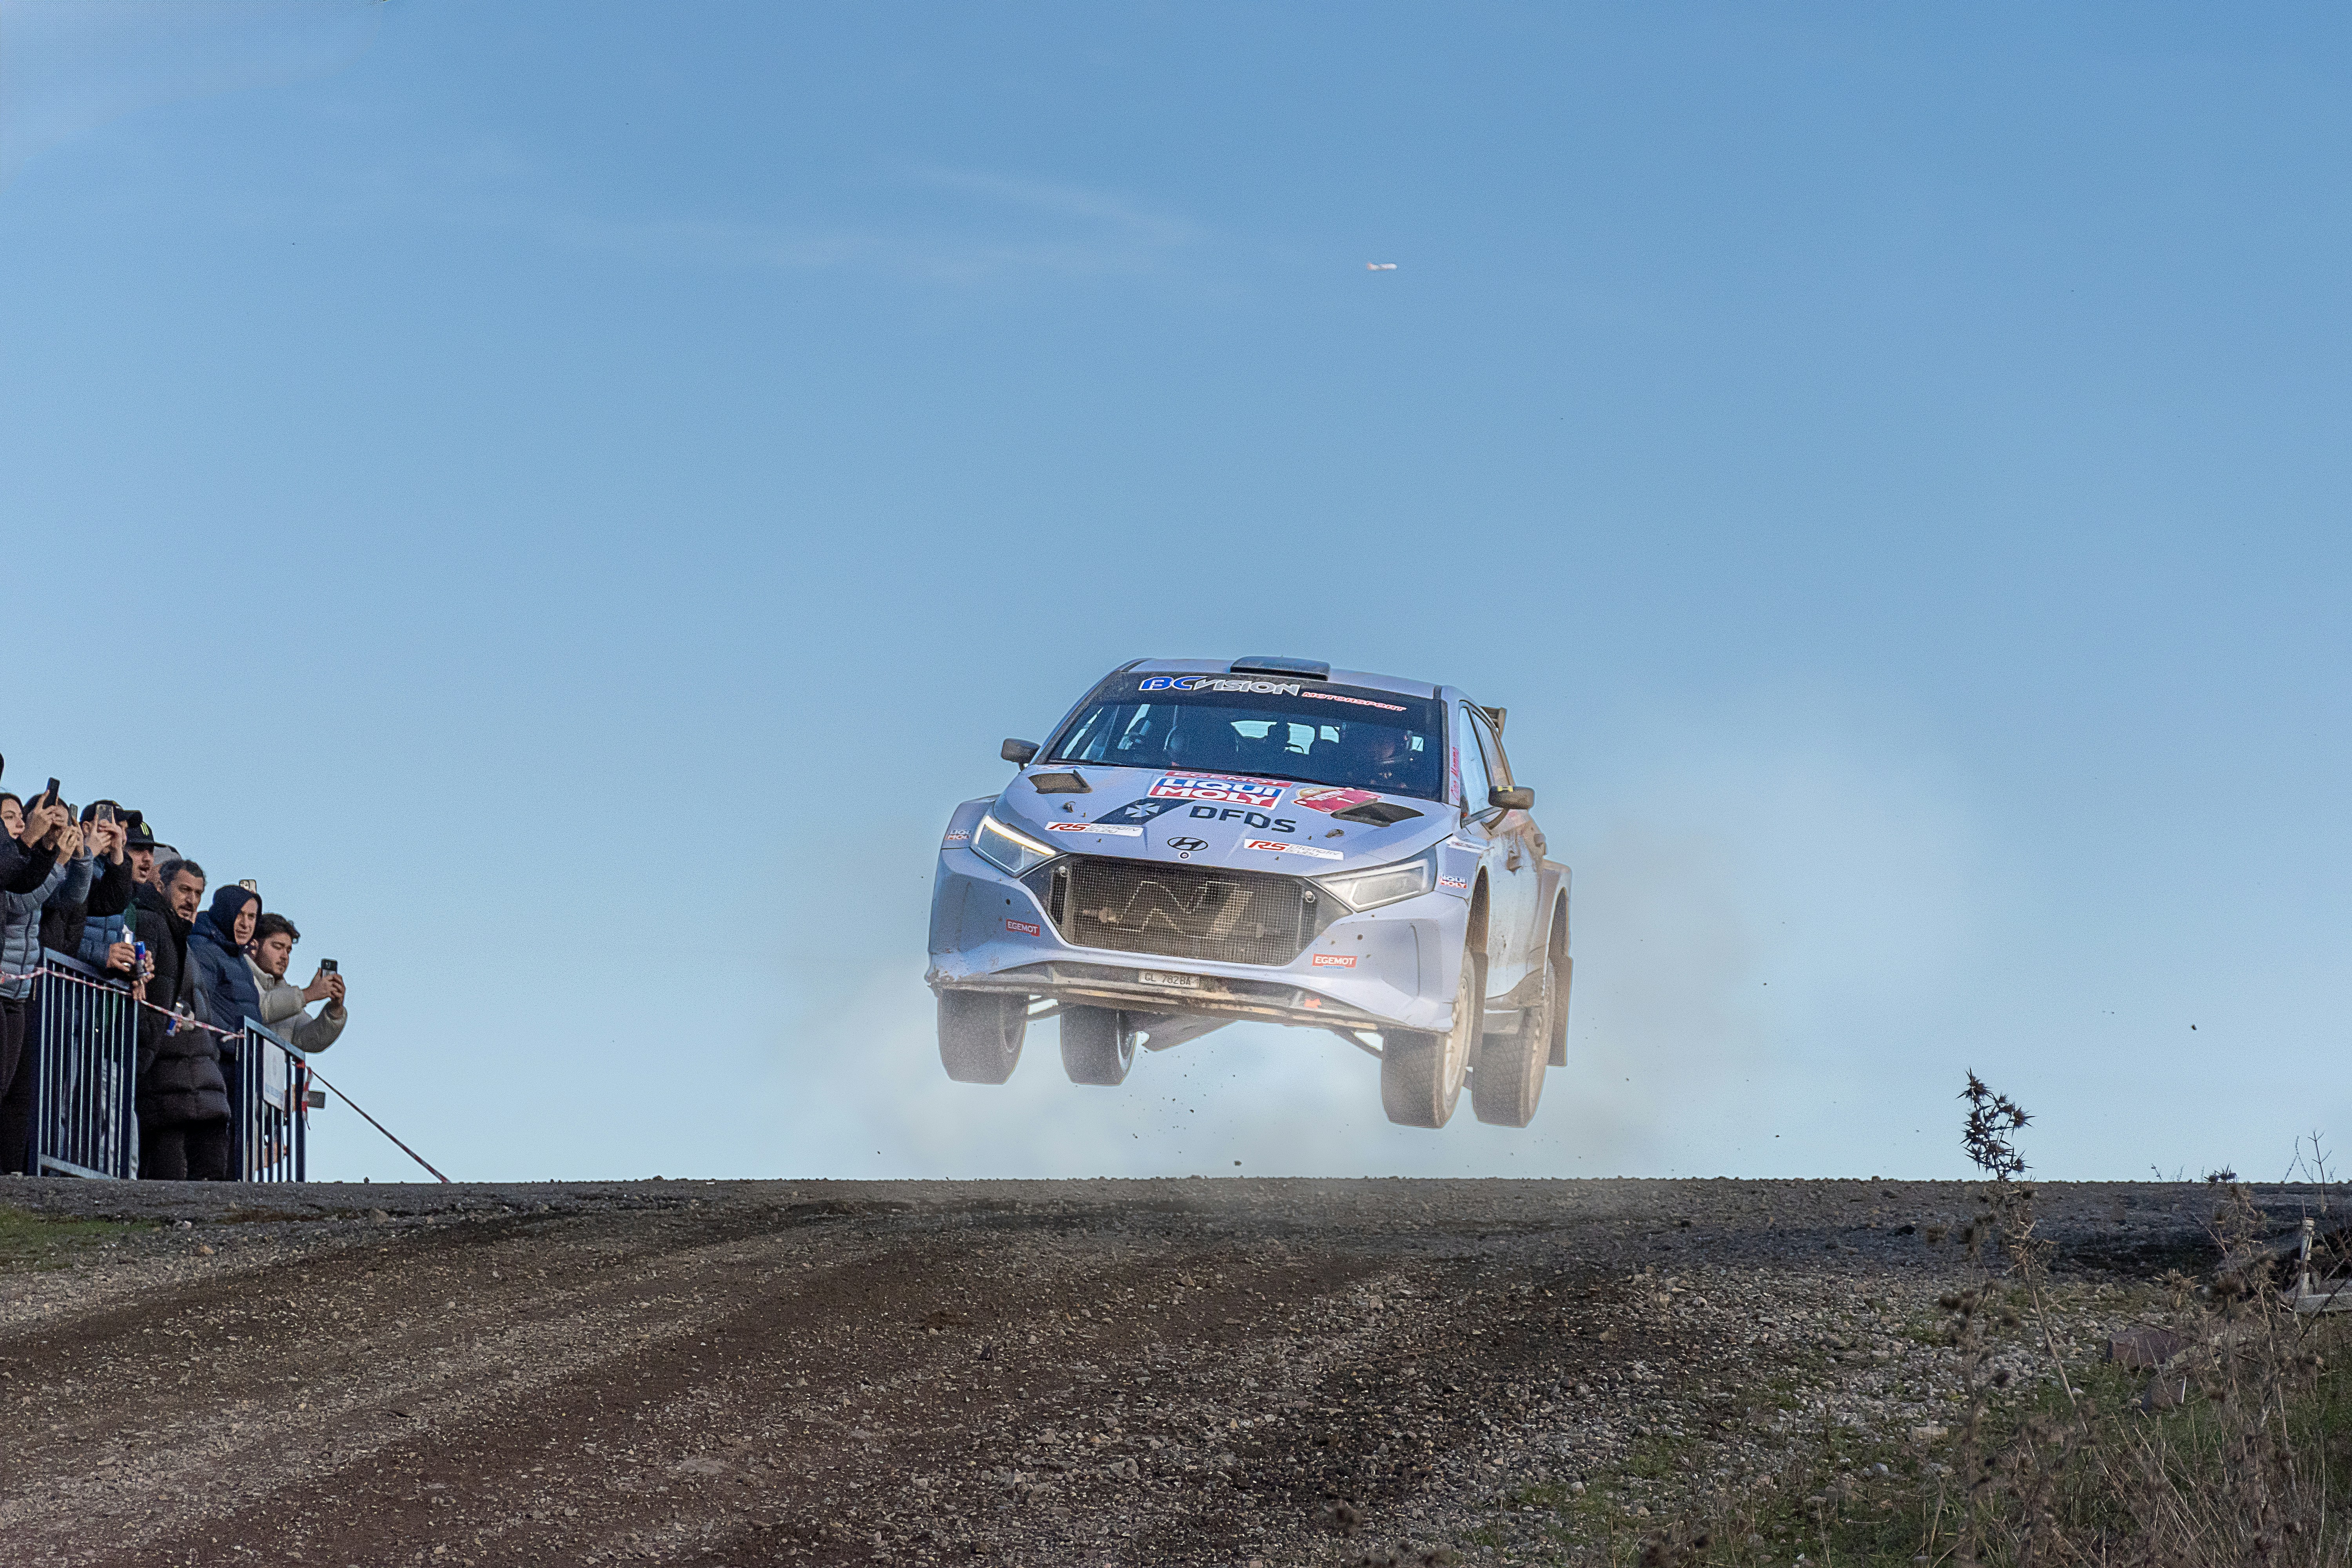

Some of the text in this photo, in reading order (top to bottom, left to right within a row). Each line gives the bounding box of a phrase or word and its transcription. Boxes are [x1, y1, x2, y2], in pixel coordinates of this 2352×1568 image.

[1301, 691, 1407, 711] MOTORSPORT
[1174, 772, 1288, 784] EGEMOT
[1163, 779, 1279, 796] LIQUI
[1157, 786, 1274, 805] MOLY
[1189, 806, 1297, 833] DFDS
[1248, 840, 1290, 851] RS
[1008, 921, 1038, 934] EGEMOT
[1315, 956, 1355, 965] EGEMOT
